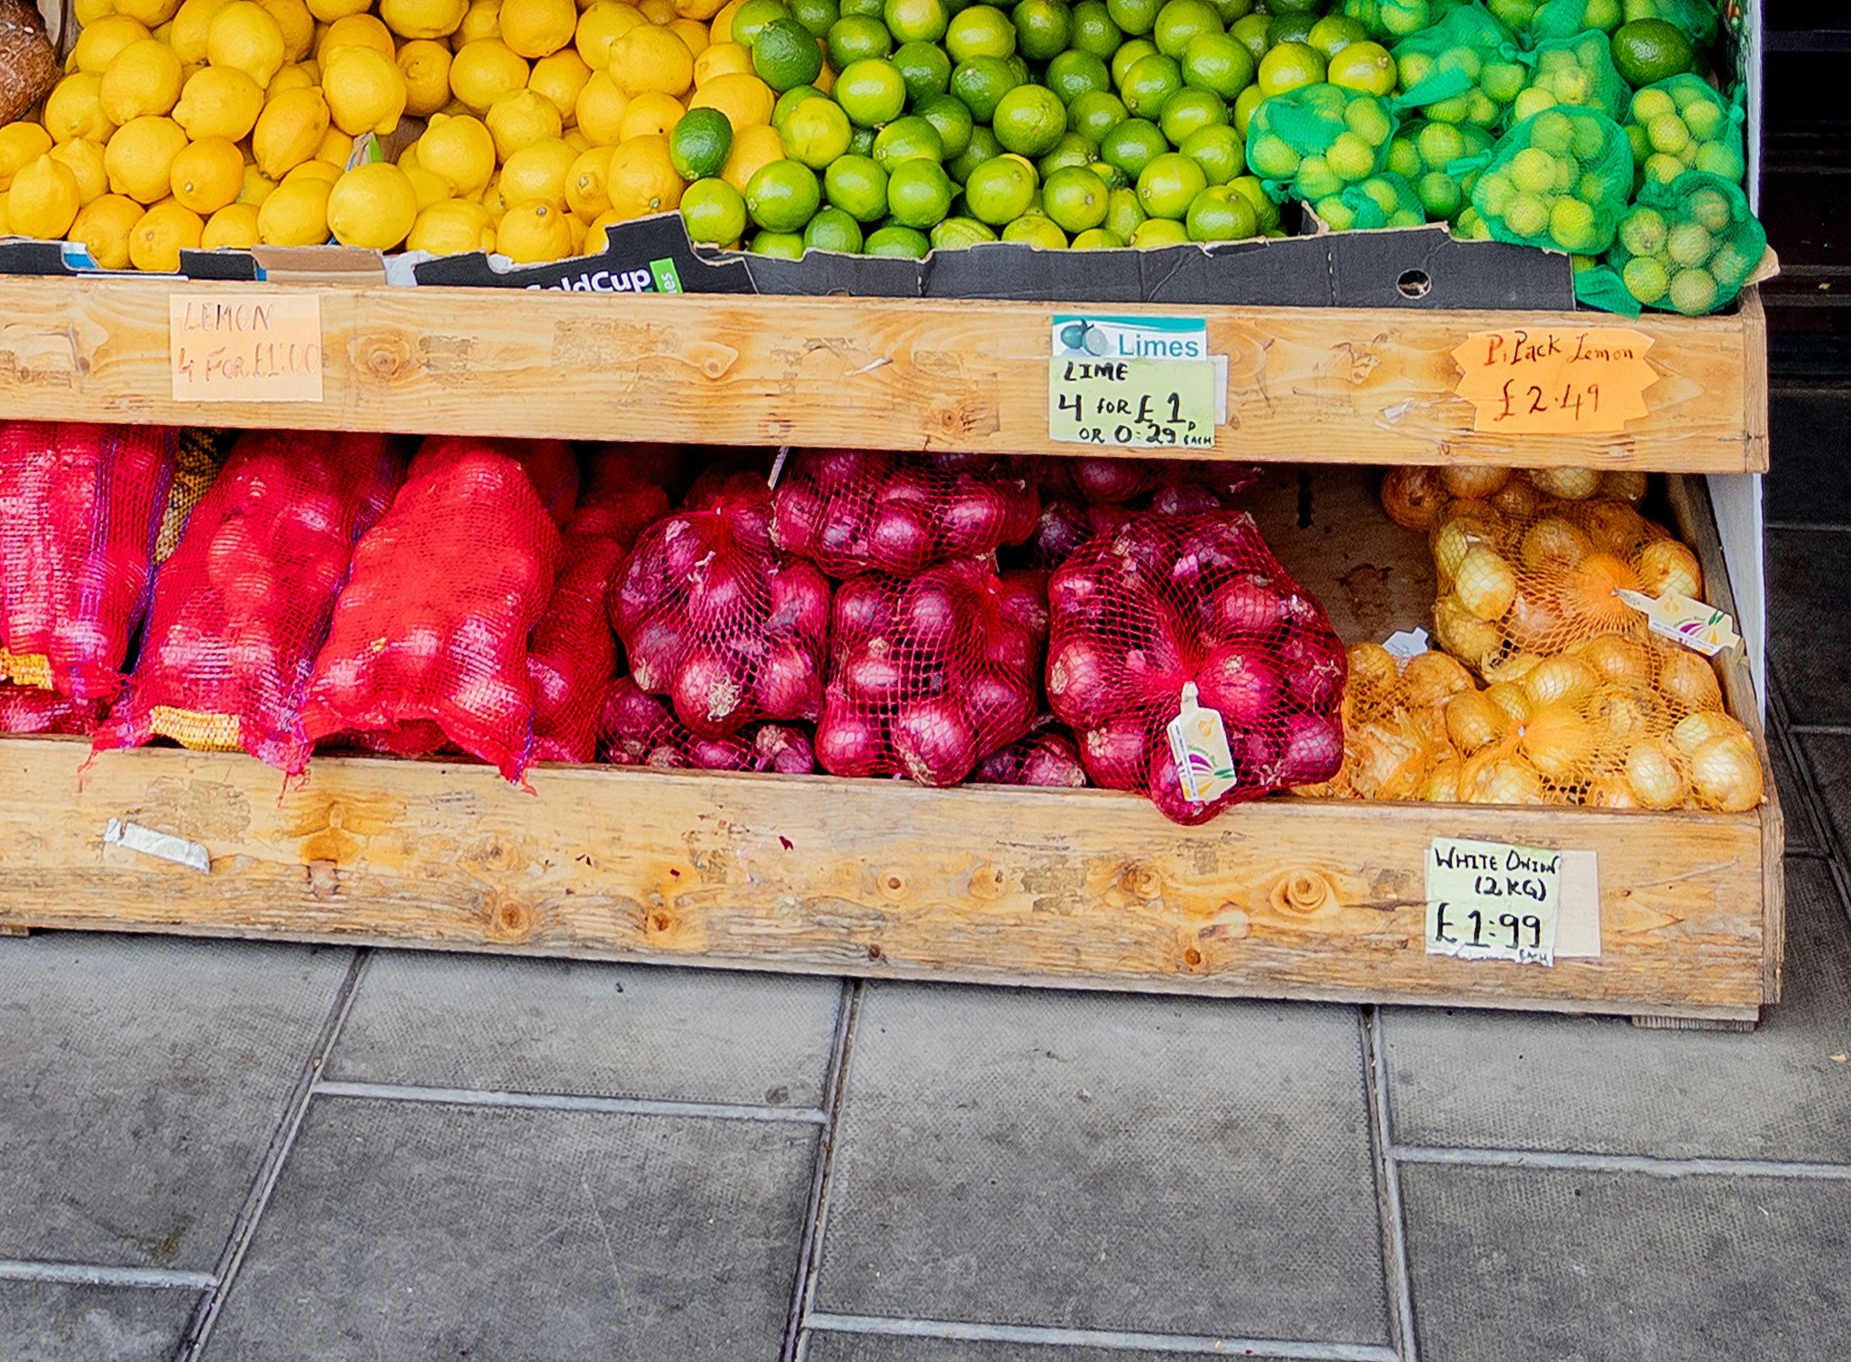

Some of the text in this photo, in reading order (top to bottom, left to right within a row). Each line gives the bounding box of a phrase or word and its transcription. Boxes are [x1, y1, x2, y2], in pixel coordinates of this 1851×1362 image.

[527, 269, 651, 293] ldCup
[183, 301, 274, 332] LEMON
[1119, 333, 1199, 357] Limes
[1566, 332, 1634, 363] Lemon
[177, 347, 194, 383] 4
[1063, 360, 1129, 381] LIME
[1058, 394, 1082, 422] 4
[1078, 427, 1106, 444] OR
[1434, 845, 1560, 875] WHITE ONION
